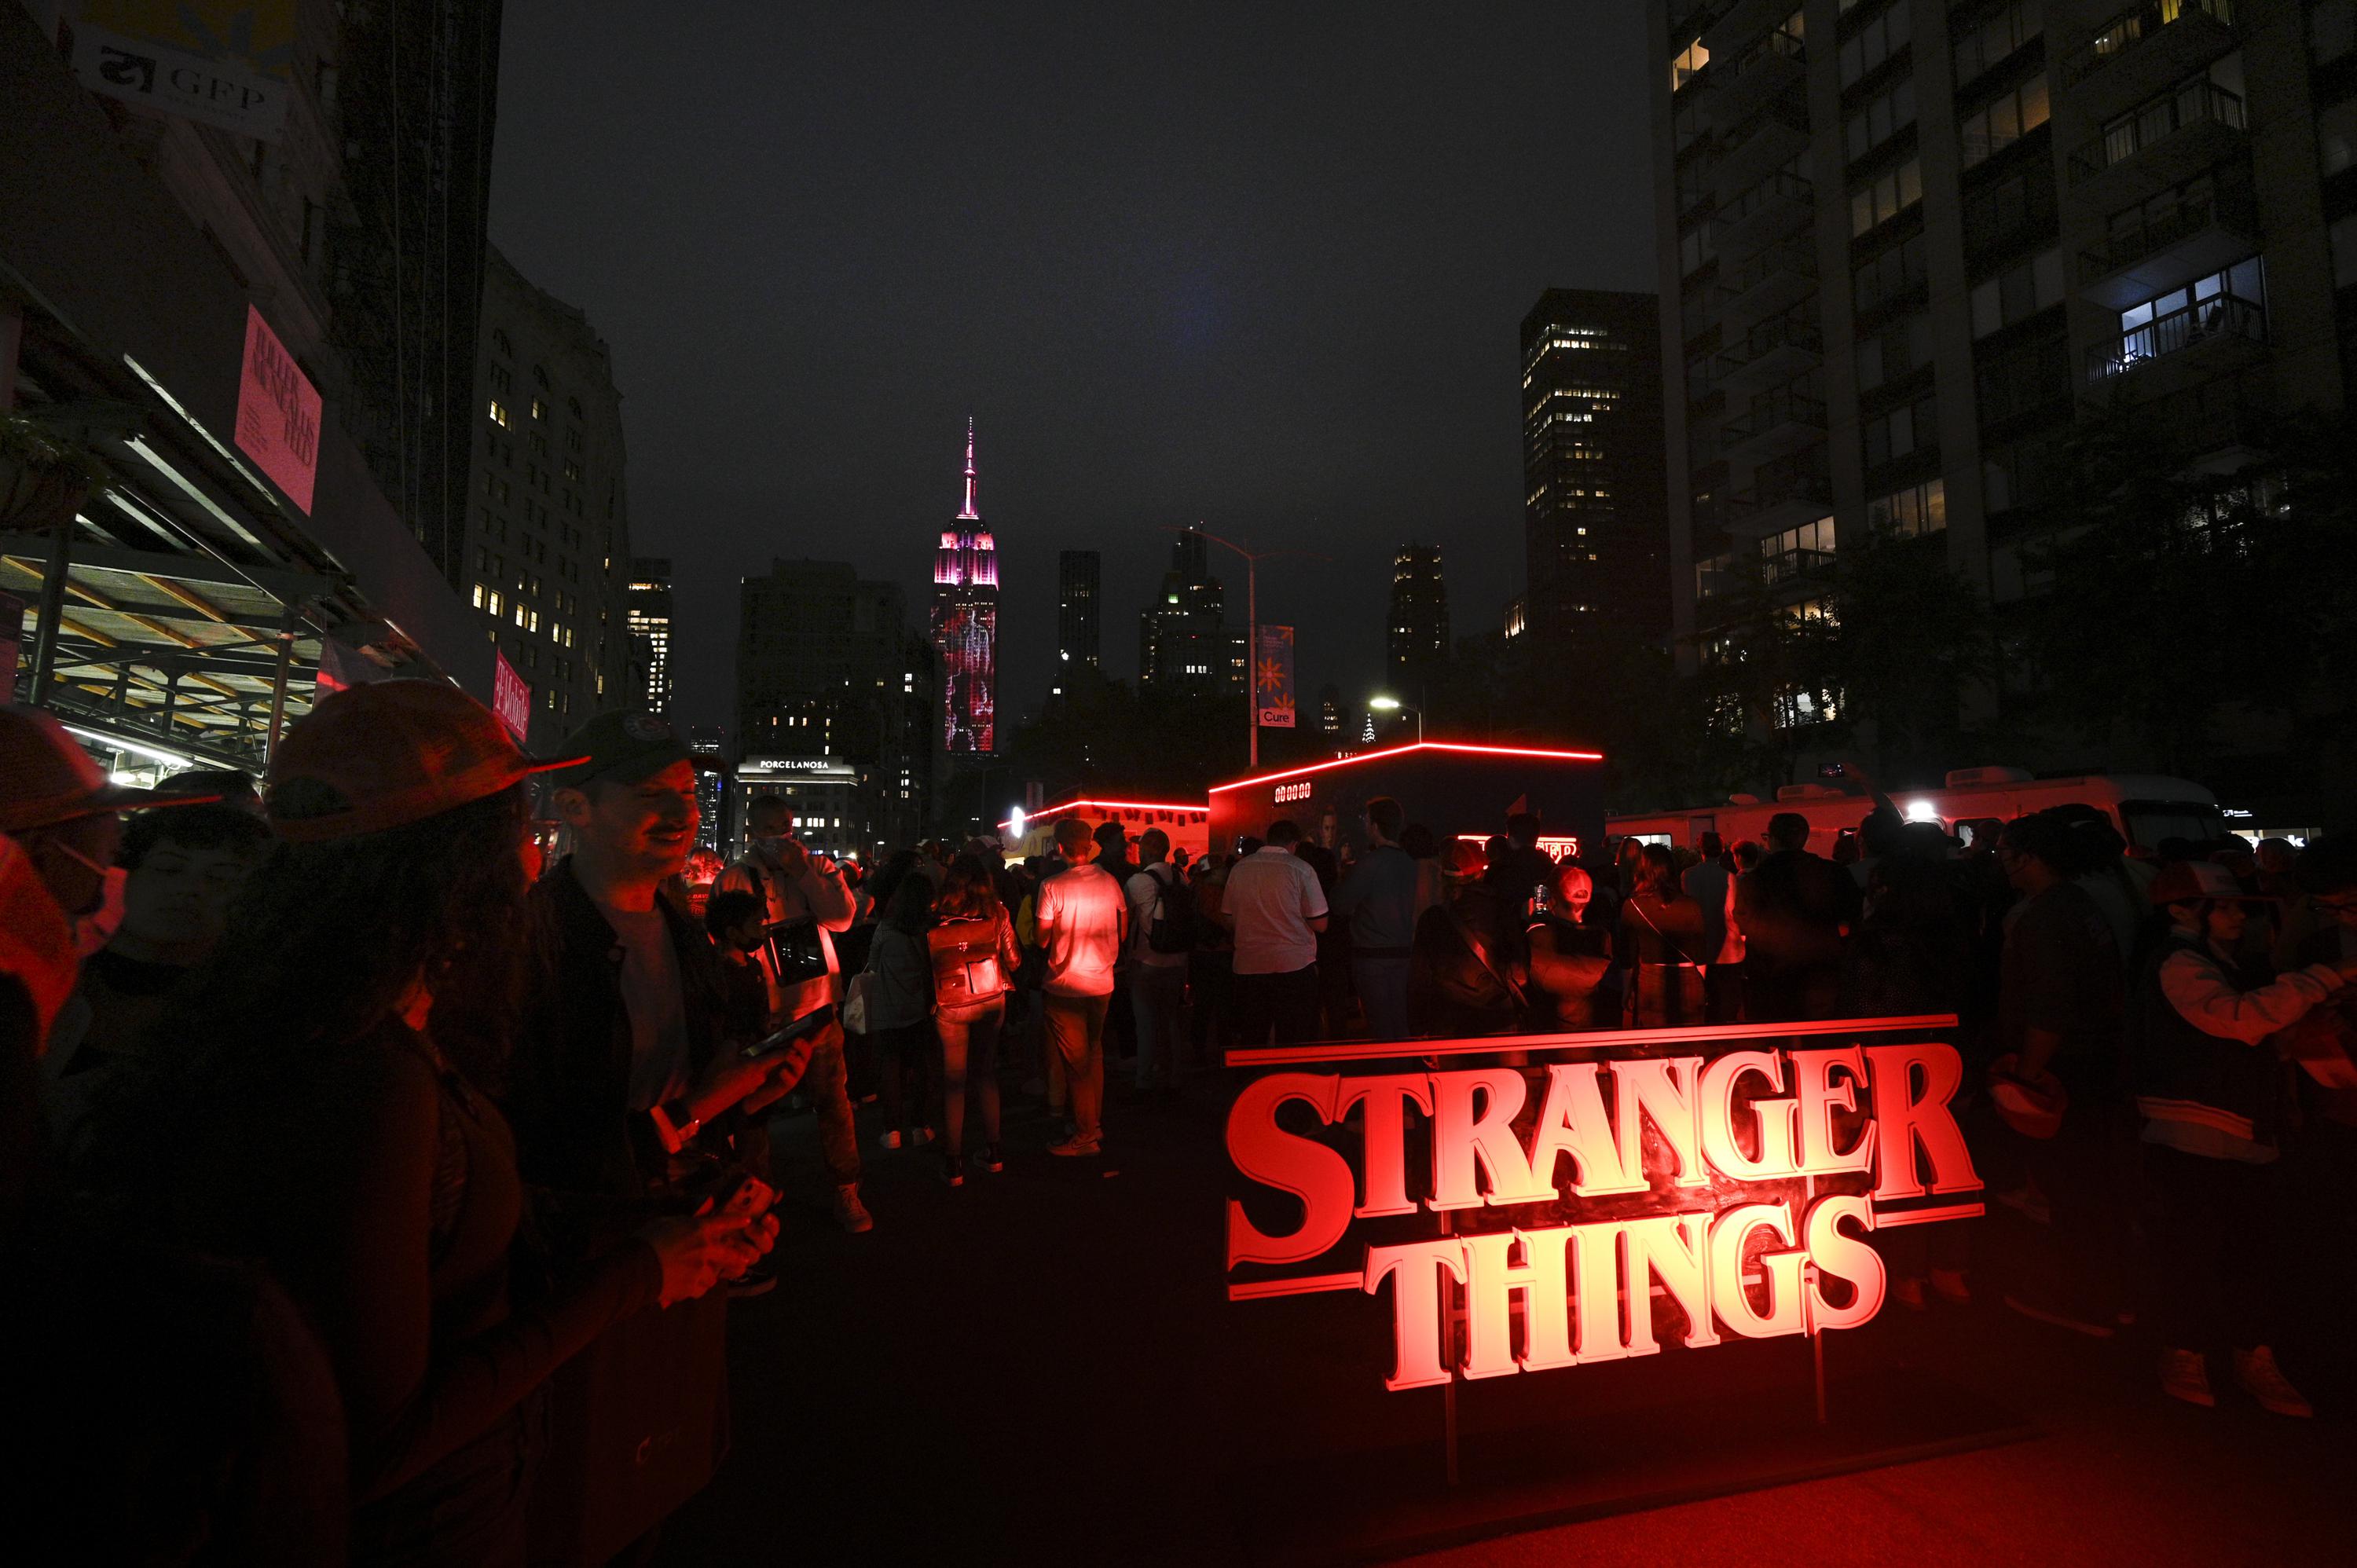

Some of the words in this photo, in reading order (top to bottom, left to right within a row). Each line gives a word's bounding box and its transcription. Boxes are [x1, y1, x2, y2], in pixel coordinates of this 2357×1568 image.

[170, 68, 266, 110] GFP
[761, 760, 829, 769] PORCELANOSA
[1225, 1042, 1985, 1272] STRANGER
[1363, 1194, 1886, 1391] THINGS
